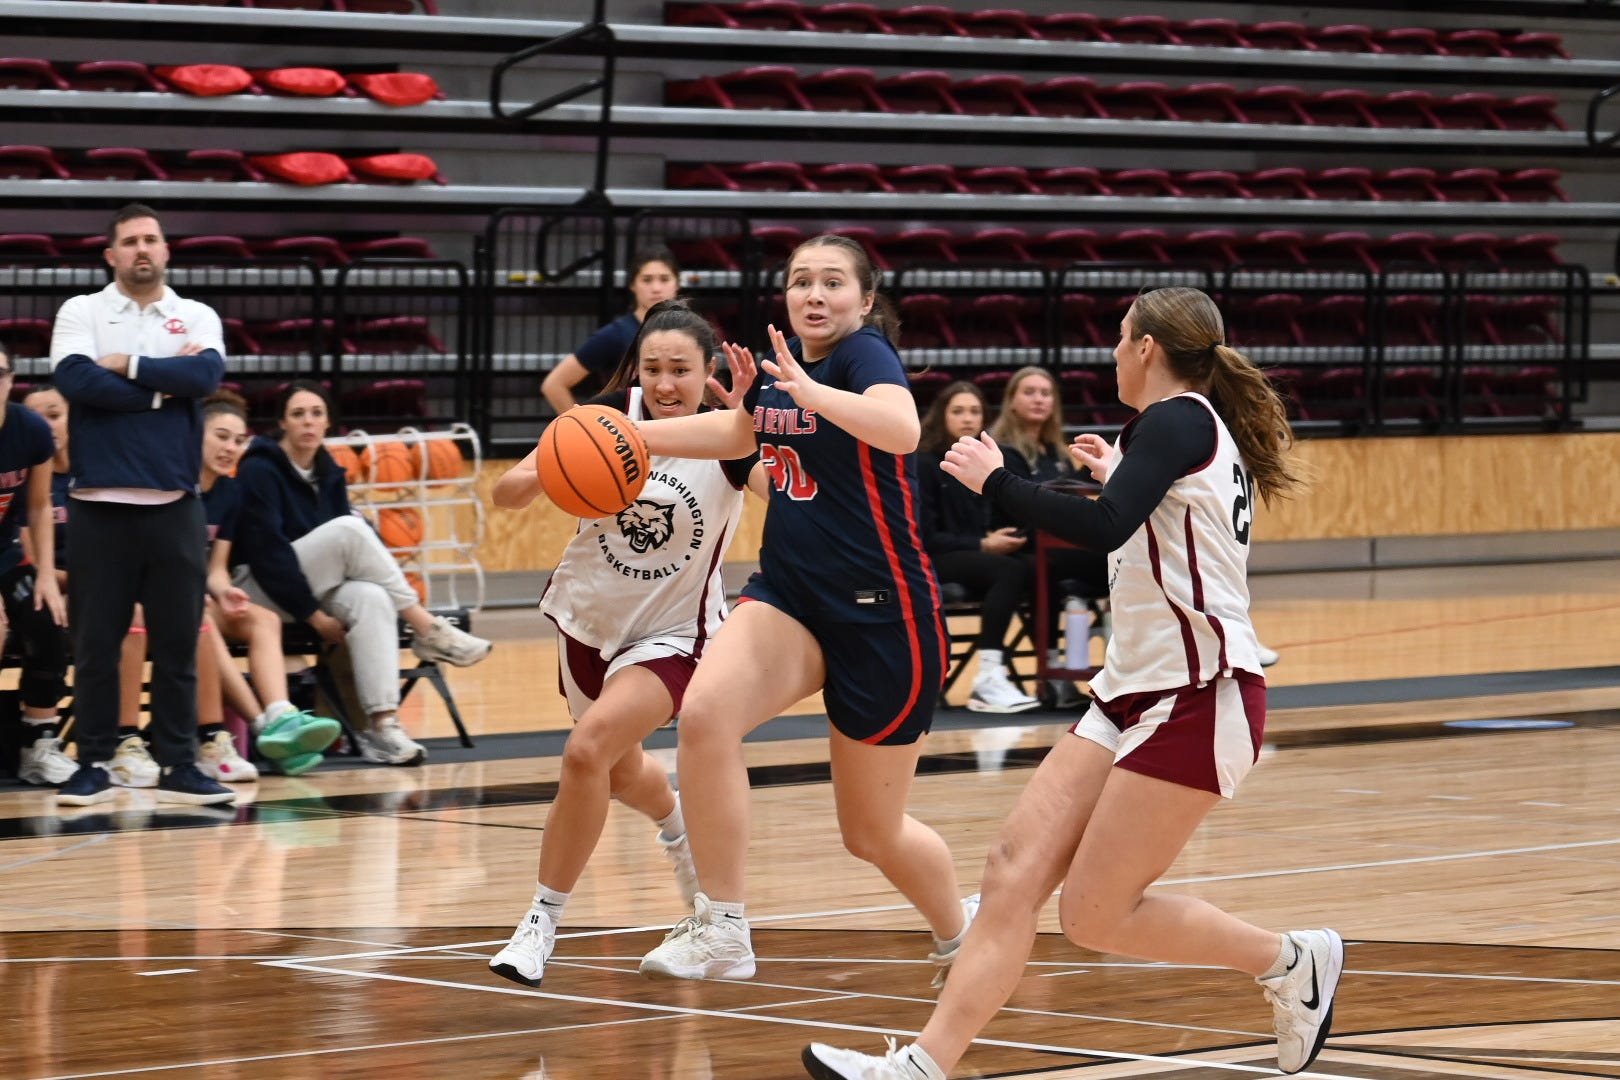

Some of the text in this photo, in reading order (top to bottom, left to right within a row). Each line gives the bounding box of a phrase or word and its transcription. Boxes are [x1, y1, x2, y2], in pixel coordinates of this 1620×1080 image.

[765, 407, 817, 435] DEVILS
[597, 416, 640, 484] Wilson
[647, 471, 704, 550] WASHINGTON
[598, 533, 680, 580] BASKETBALL
